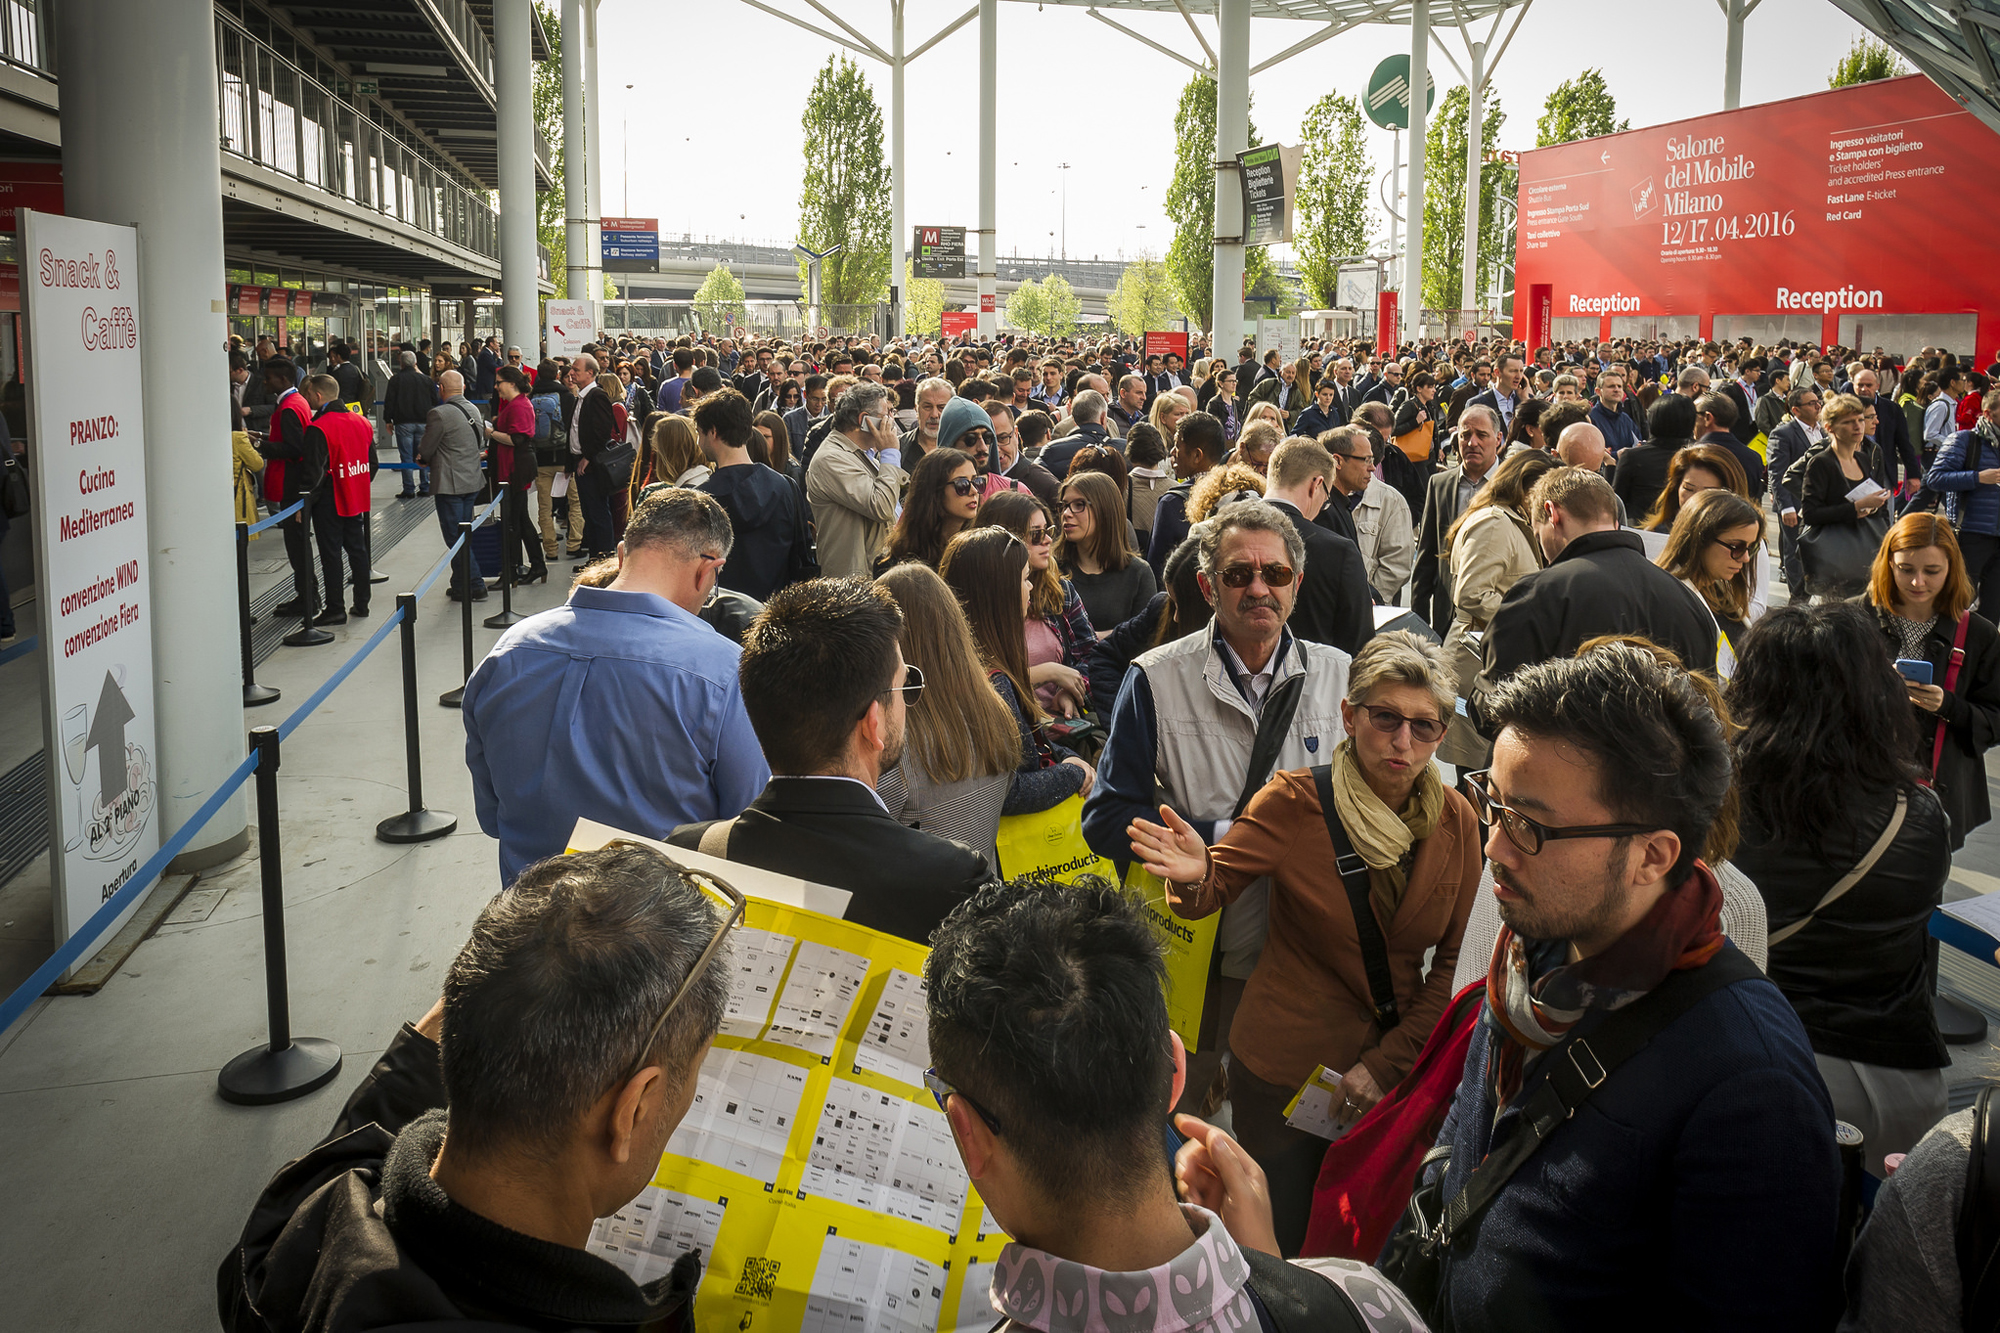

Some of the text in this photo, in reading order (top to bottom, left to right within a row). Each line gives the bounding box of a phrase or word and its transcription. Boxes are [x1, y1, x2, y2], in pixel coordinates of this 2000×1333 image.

[1666, 134, 1725, 162] Salone
[1829, 141, 1924, 162] e Stampa con biglietto
[1830, 129, 1904, 150] Ingresso visitatori
[1246, 165, 1271, 178] Reception
[1665, 154, 1755, 190] del Mobile
[1827, 165, 1945, 187] and accredited Press entrance
[1829, 162, 1851, 174] Ticket
[1249, 189, 1267, 199] Tickets
[1662, 191, 1723, 217] Milano
[1827, 188, 1897, 204] Fast Lane E-ticket
[1661, 209, 1796, 246] 12/17.04.2016
[1826, 209, 1862, 221] Red Card
[924, 231, 938, 244] M
[39, 248, 120, 290] Snack &
[550, 305, 585, 316] Snack &
[1569, 292, 1640, 316] Reception
[1776, 284, 1883, 314] Reception
[81, 306, 137, 351] Caffè
[70, 414, 119, 446] PRANZO:
[79, 465, 115, 495] Cucina
[339, 459, 370, 478] i Salo
[60, 501, 134, 542] Mediterranea
[60, 559, 139, 618] convenzione WIND
[64, 603, 139, 658] convenzione Fiera
[90, 822, 103, 846] AL
[113, 789, 140, 825] PIANO
[101, 857, 138, 904] Apertura
